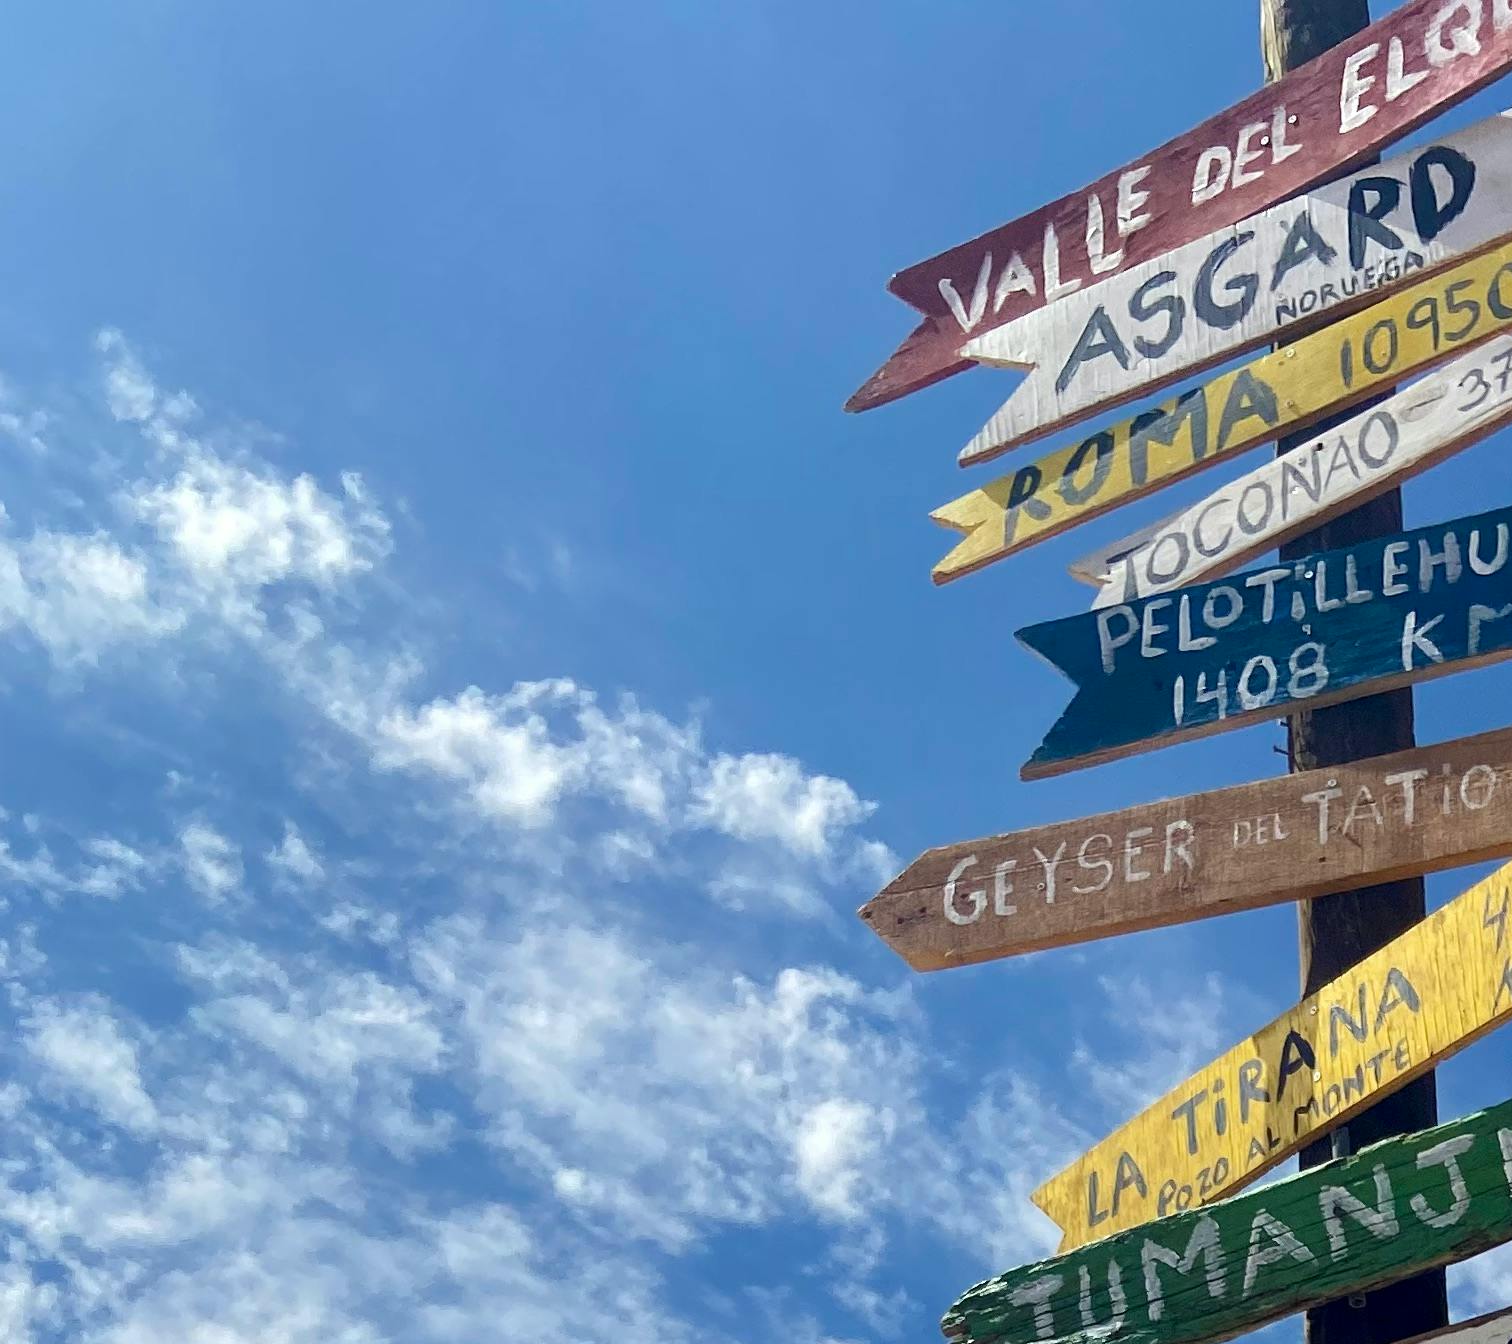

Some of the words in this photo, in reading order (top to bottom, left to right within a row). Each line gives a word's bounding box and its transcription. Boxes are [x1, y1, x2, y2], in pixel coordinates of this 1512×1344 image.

[938, 165, 1152, 334] VALLE
[1191, 105, 1304, 208] DEL
[1055, 145, 1476, 394] ASGARD
[1274, 250, 1425, 327] NORUEGA
[1003, 368, 1281, 548] ROMA
[1105, 410, 1399, 601] TOCONAO
[1173, 641, 1330, 728] 1408
[942, 819, 1196, 926] GEYSER
[1232, 812, 1291, 849] DEL
[1086, 1151, 1148, 1228] LA
[1157, 1157, 1230, 1219] POZO
[1247, 1126, 1281, 1167] AL
[1292, 1036, 1413, 1139] MONTE
